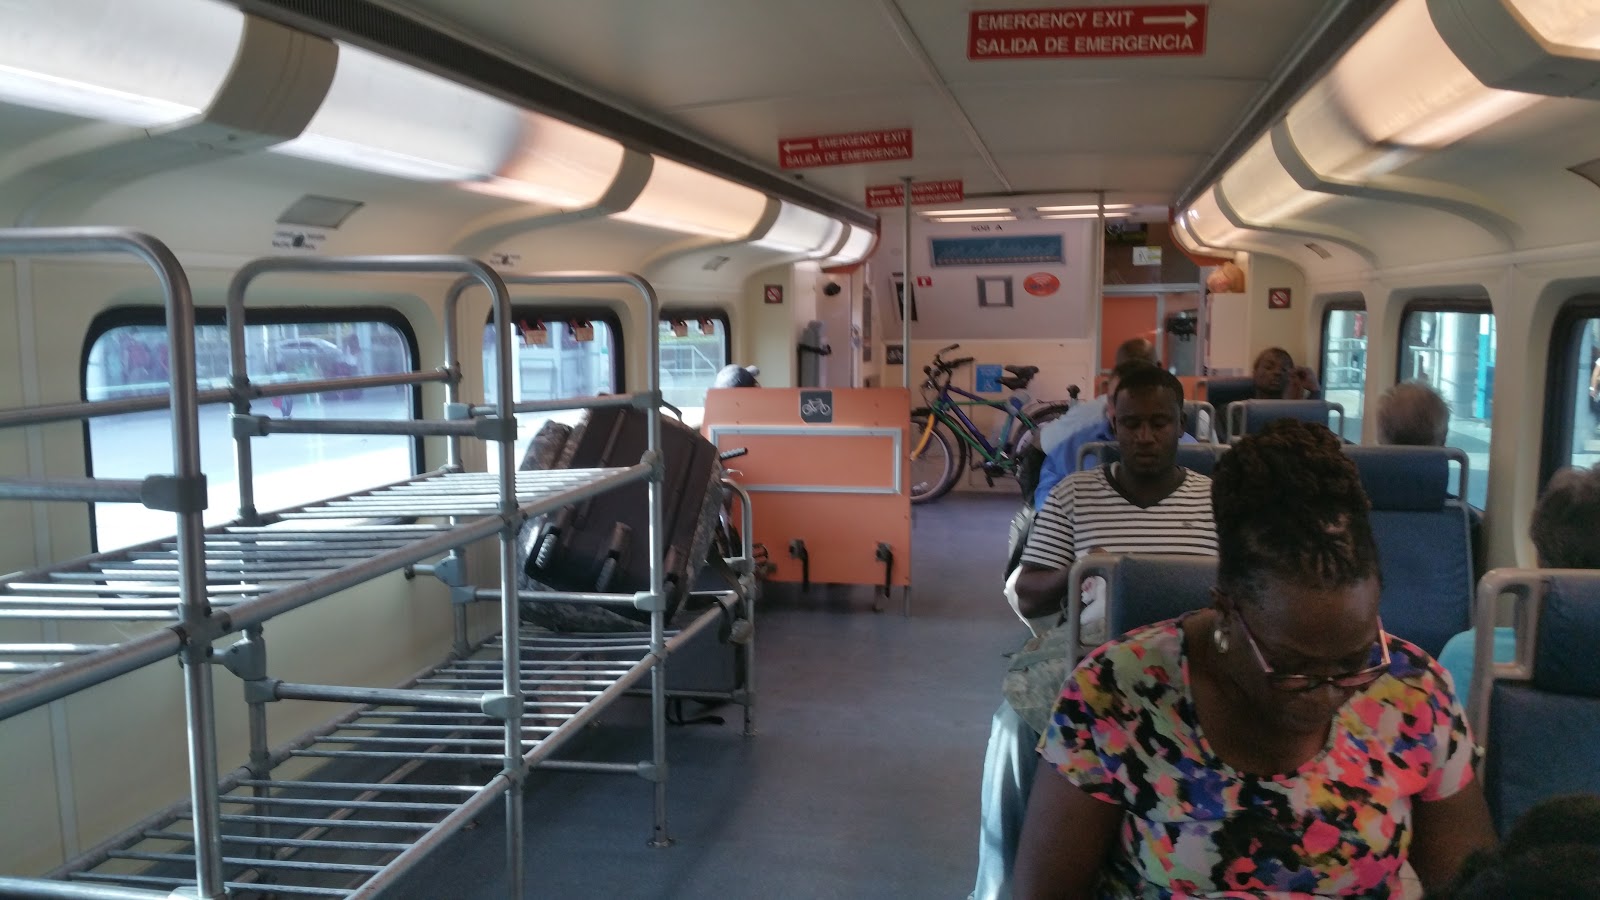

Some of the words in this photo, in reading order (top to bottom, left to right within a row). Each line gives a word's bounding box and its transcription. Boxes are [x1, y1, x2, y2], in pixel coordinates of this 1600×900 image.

[977, 12, 1087, 31] EMERGENCY
[1092, 10, 1135, 28] EXIT
[976, 37, 1039, 55] SALIDA
[1044, 36, 1069, 53] DE
[1074, 34, 1193, 52] EMERGENCIA
[818, 133, 881, 149] EMERGENCY
[883, 131, 908, 144] EXIT
[785, 152, 822, 167] SALIDA
[824, 150, 839, 162] DE
[841, 145, 909, 161] EMERGENCIA
